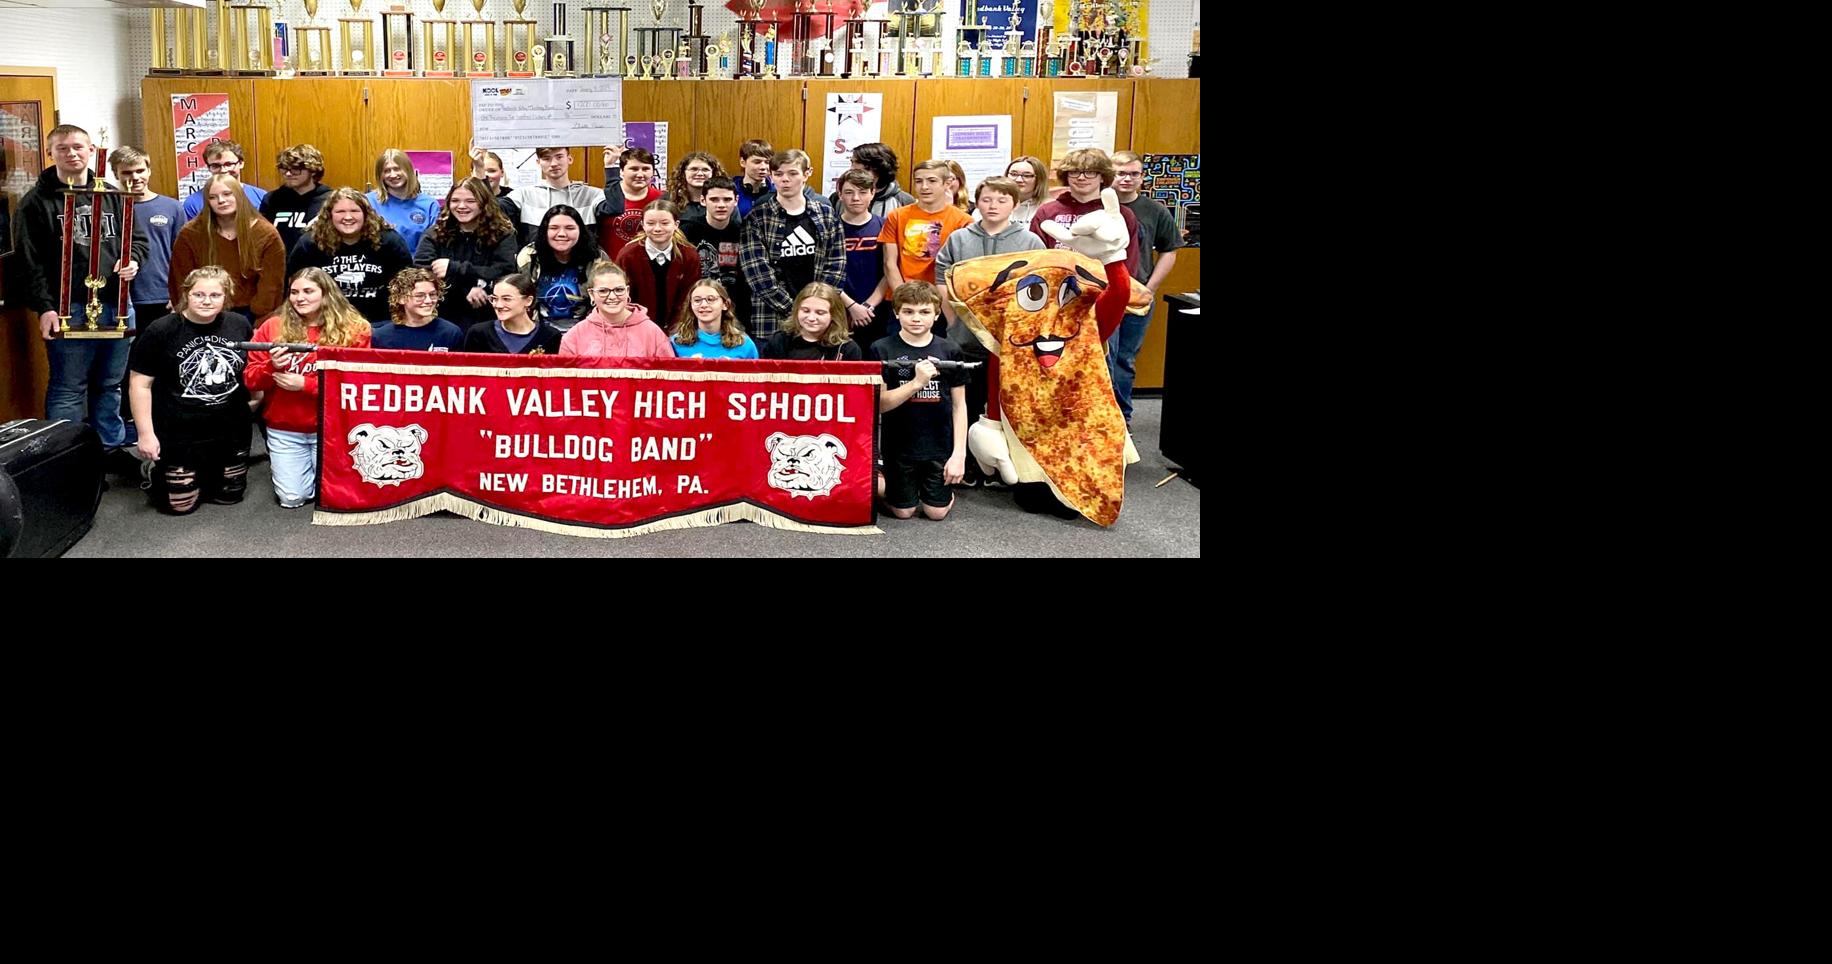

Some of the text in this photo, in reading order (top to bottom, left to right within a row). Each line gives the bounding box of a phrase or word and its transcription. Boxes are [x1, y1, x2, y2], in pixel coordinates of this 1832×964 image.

[180, 98, 200, 195] MARCHIN
[340, 255, 358, 264] THE
[780, 244, 815, 257] adida
[322, 263, 383, 274] EST PLAYERS
[340, 383, 856, 423] REDBANK VALLEY HIGH SCHOOL
[917, 390, 941, 399] HOUSE
[479, 429, 713, 463] "BULLDOG BAND"
[480, 472, 709, 499] NEW BETHLEHEM, PA.
